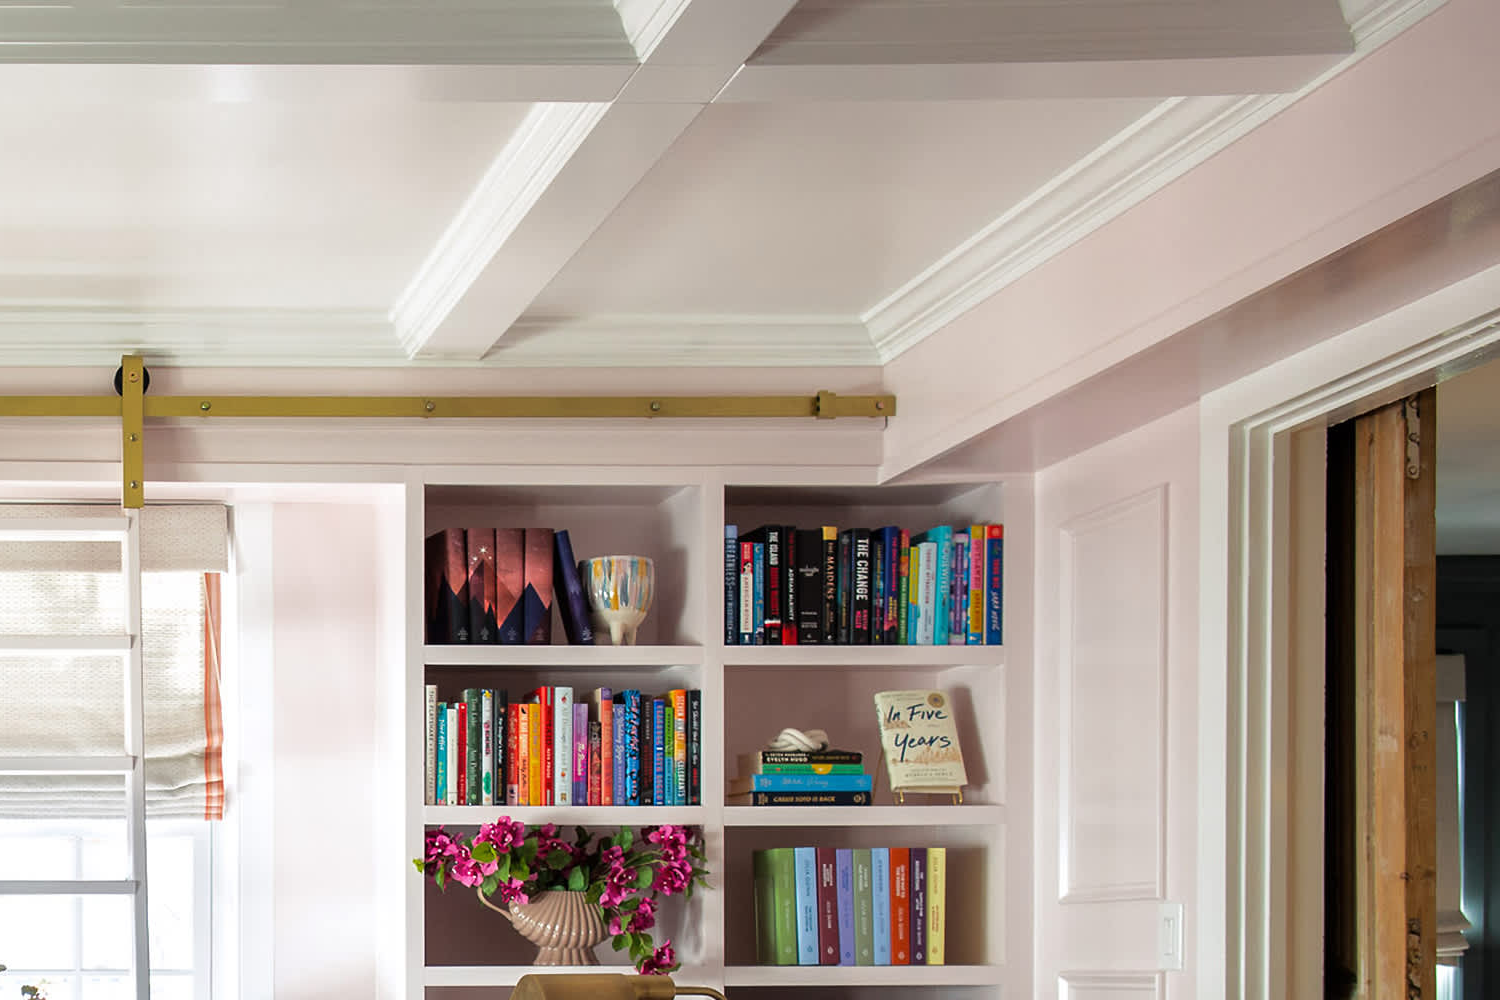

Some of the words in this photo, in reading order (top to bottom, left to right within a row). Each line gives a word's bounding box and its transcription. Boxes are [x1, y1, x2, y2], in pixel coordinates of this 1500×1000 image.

[769, 532, 778, 543] THE
[857, 539, 868, 557] THE
[726, 539, 736, 586] BREATHLESS
[769, 544, 778, 565] ISLAND
[857, 560, 868, 600] CHANGE
[888, 704, 900, 724] In
[907, 703, 948, 721] Five
[894, 733, 951, 763] Years
